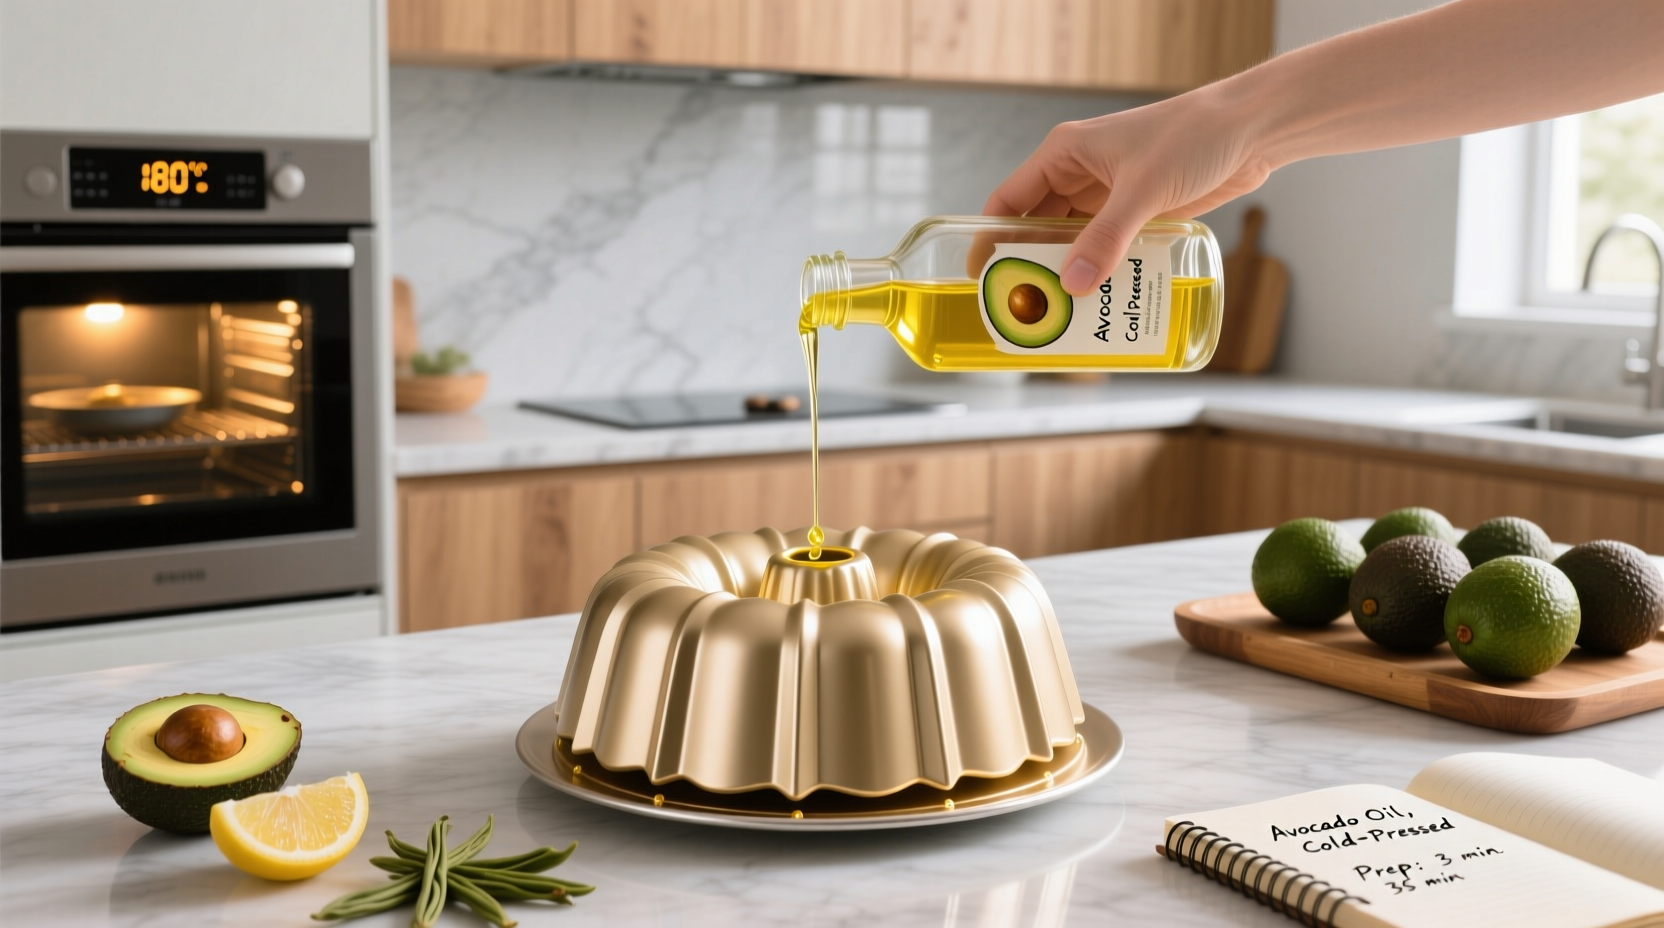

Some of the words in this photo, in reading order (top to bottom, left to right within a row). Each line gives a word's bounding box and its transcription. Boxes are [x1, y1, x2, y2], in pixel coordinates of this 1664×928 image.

[1271, 815, 1359, 841] Avocado
[1365, 805, 1413, 820] Oil,
[1303, 817, 1455, 853] Cold-Pressed
[1353, 862, 1423, 881] Prep:
[1435, 853, 1452, 866] 3
[1461, 846, 1504, 861] min
[1385, 880, 1416, 895] 35
[1425, 872, 1464, 887] min
